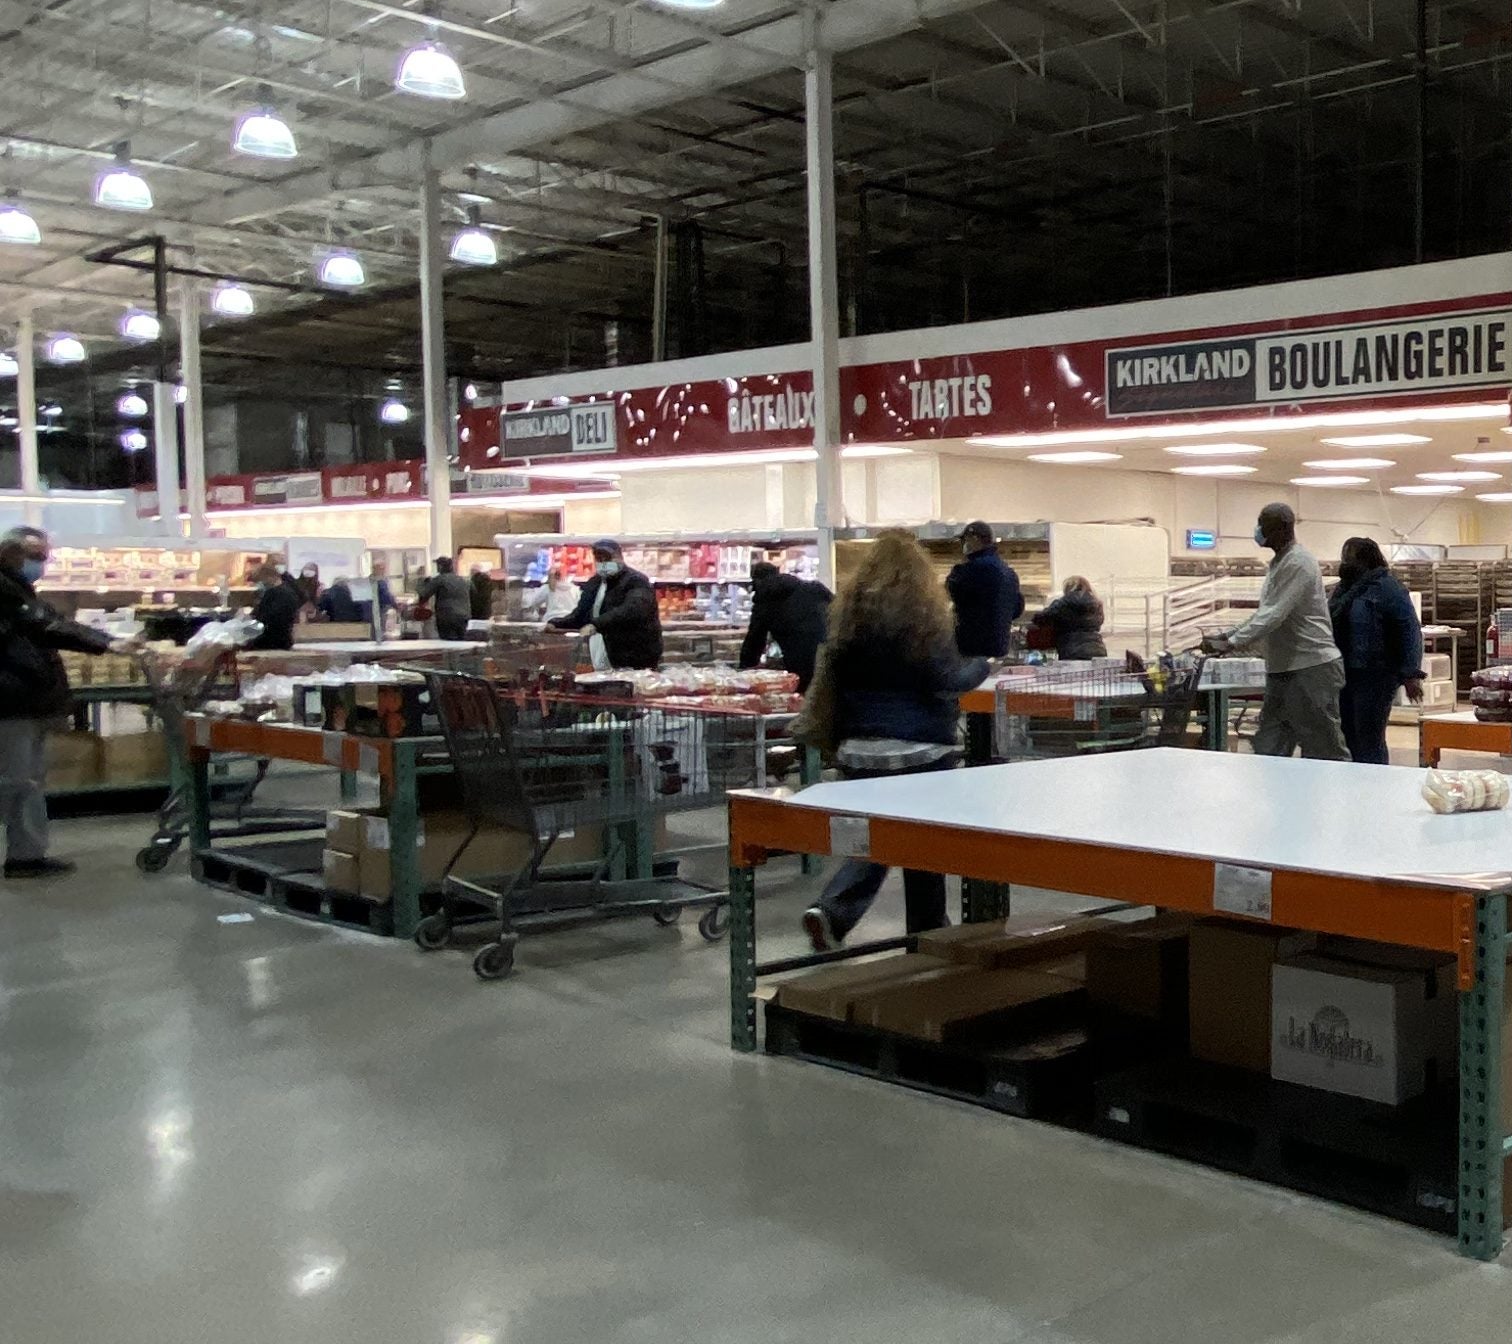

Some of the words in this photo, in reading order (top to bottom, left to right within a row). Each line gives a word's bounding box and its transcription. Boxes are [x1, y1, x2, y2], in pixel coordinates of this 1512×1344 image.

[1116, 347, 1251, 388] KIRKLAND
[1268, 321, 1506, 392] BOULANGERIE
[727, 388, 816, 434] GÂTEAUX
[908, 374, 993, 422] TARTES
[576, 411, 608, 445] DELI
